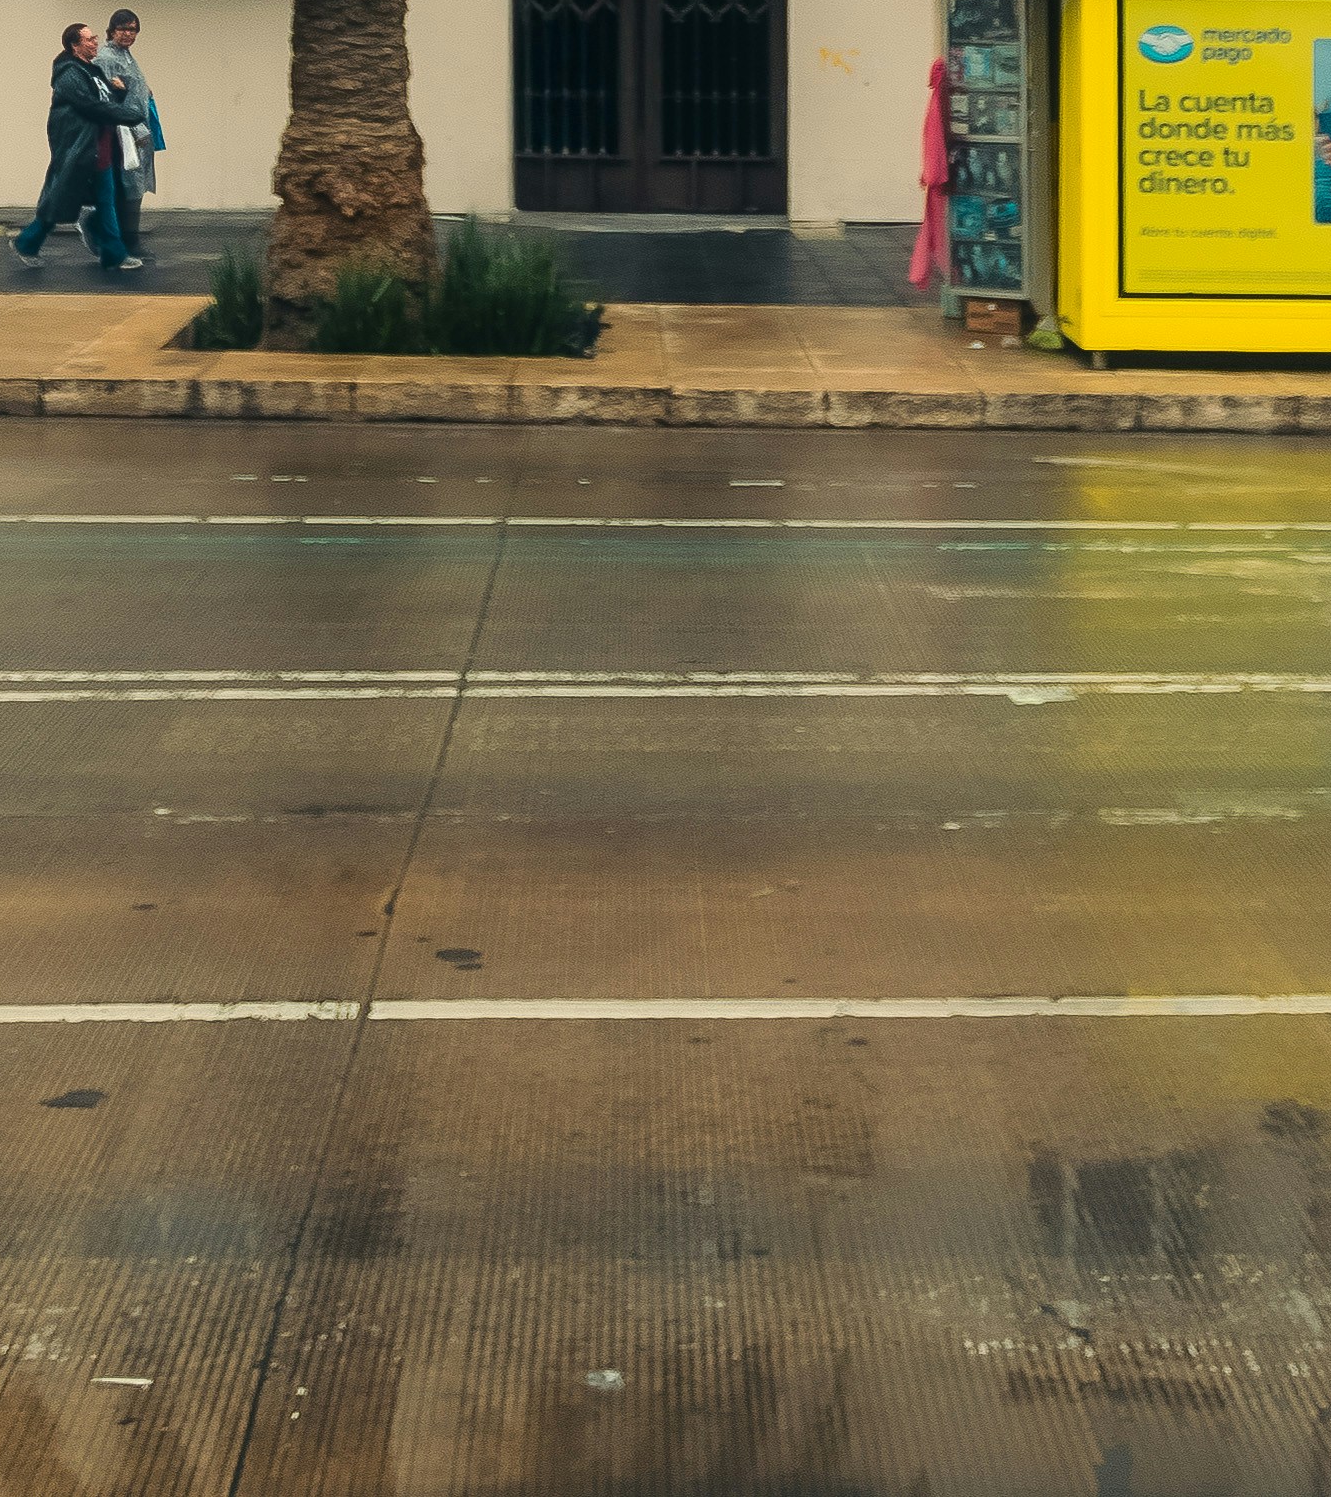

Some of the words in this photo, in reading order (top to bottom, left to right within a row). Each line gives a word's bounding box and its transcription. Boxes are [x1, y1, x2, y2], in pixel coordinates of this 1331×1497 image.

[1202, 27, 1292, 44] mercado
[1202, 47, 1253, 65] pago
[1138, 89, 1169, 112] La
[1179, 91, 1274, 114] cuenta
[1138, 117, 1228, 141] donde
[1236, 119, 1295, 142] más
[1138, 147, 1214, 167] crece
[1223, 146, 1250, 168] tu
[1138, 171, 1235, 195] dinero.
